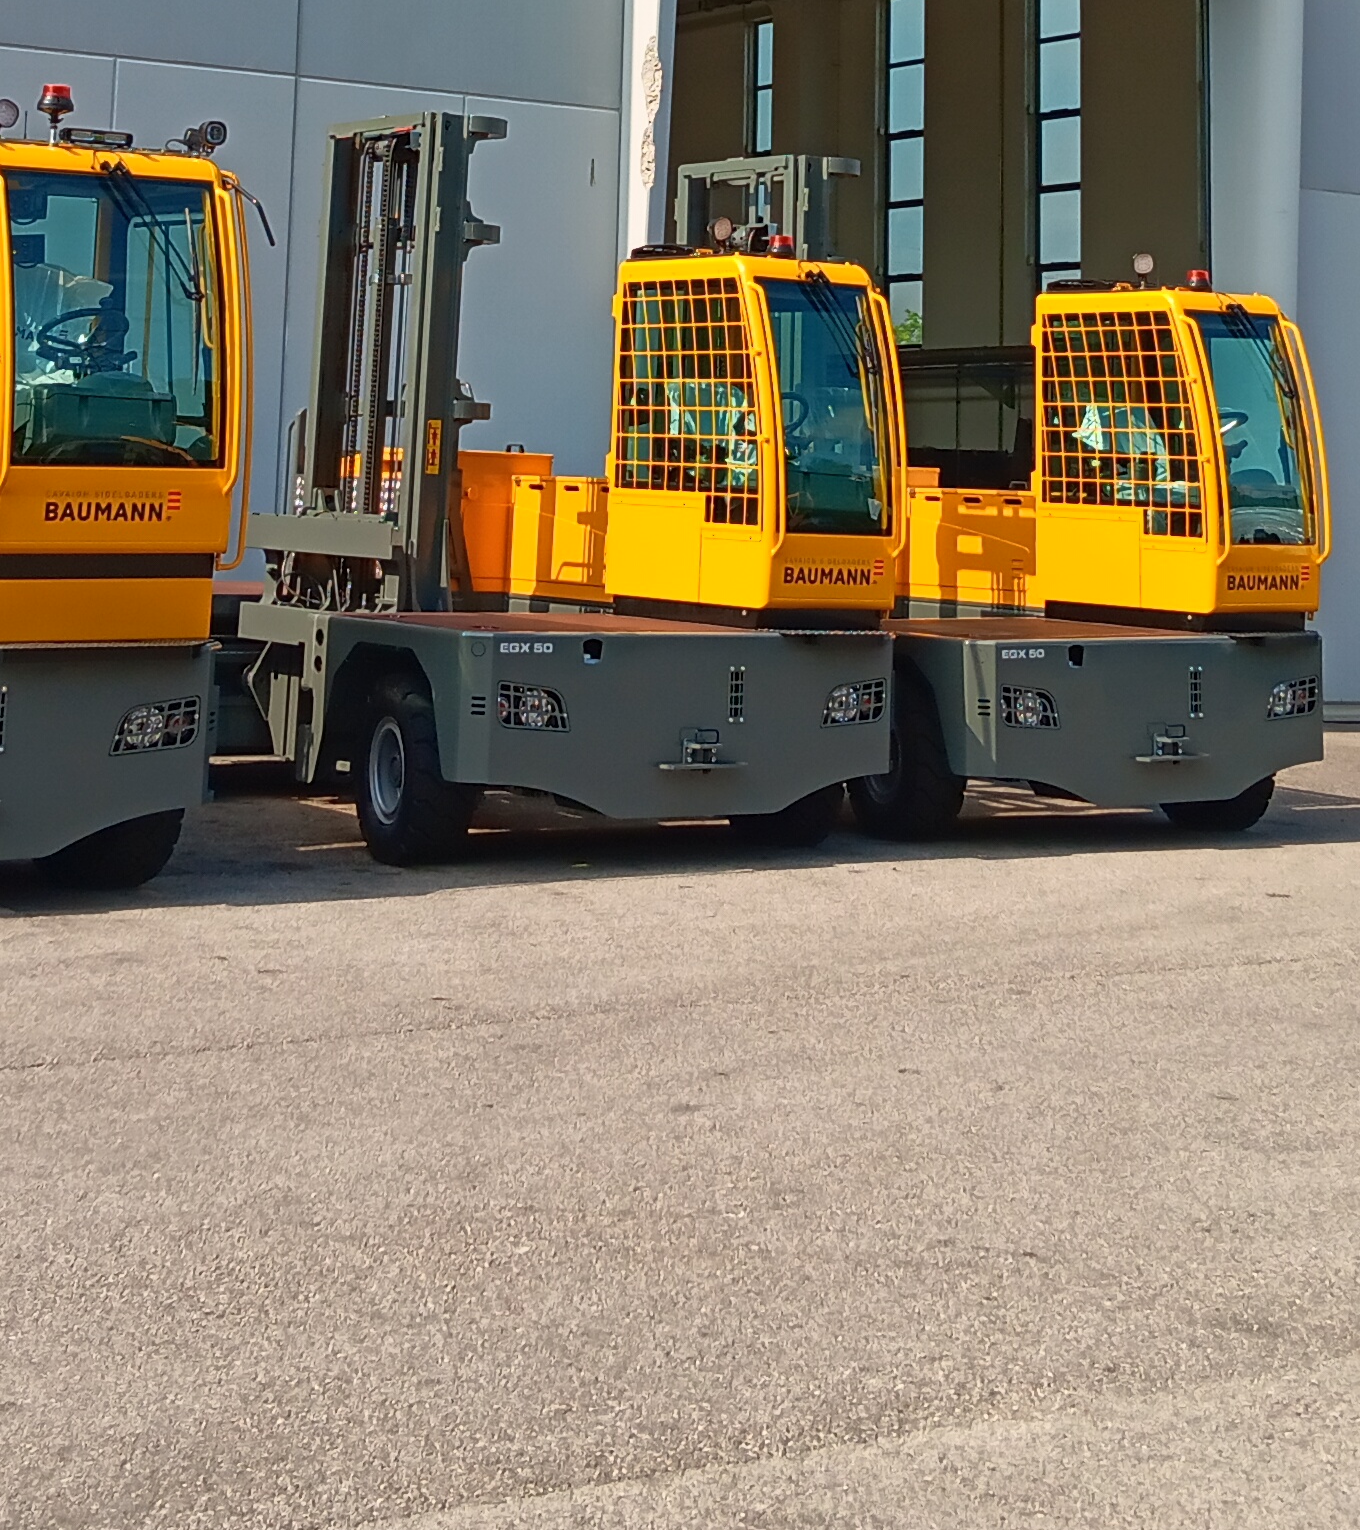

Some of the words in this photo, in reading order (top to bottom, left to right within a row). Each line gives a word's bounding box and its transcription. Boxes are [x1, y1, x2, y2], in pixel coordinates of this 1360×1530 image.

[44, 501, 164, 522] BAUMANN
[783, 566, 871, 585] BAUMANN
[1227, 575, 1299, 590] BAUMANN
[499, 642, 530, 653] EGX
[533, 642, 553, 653] 50
